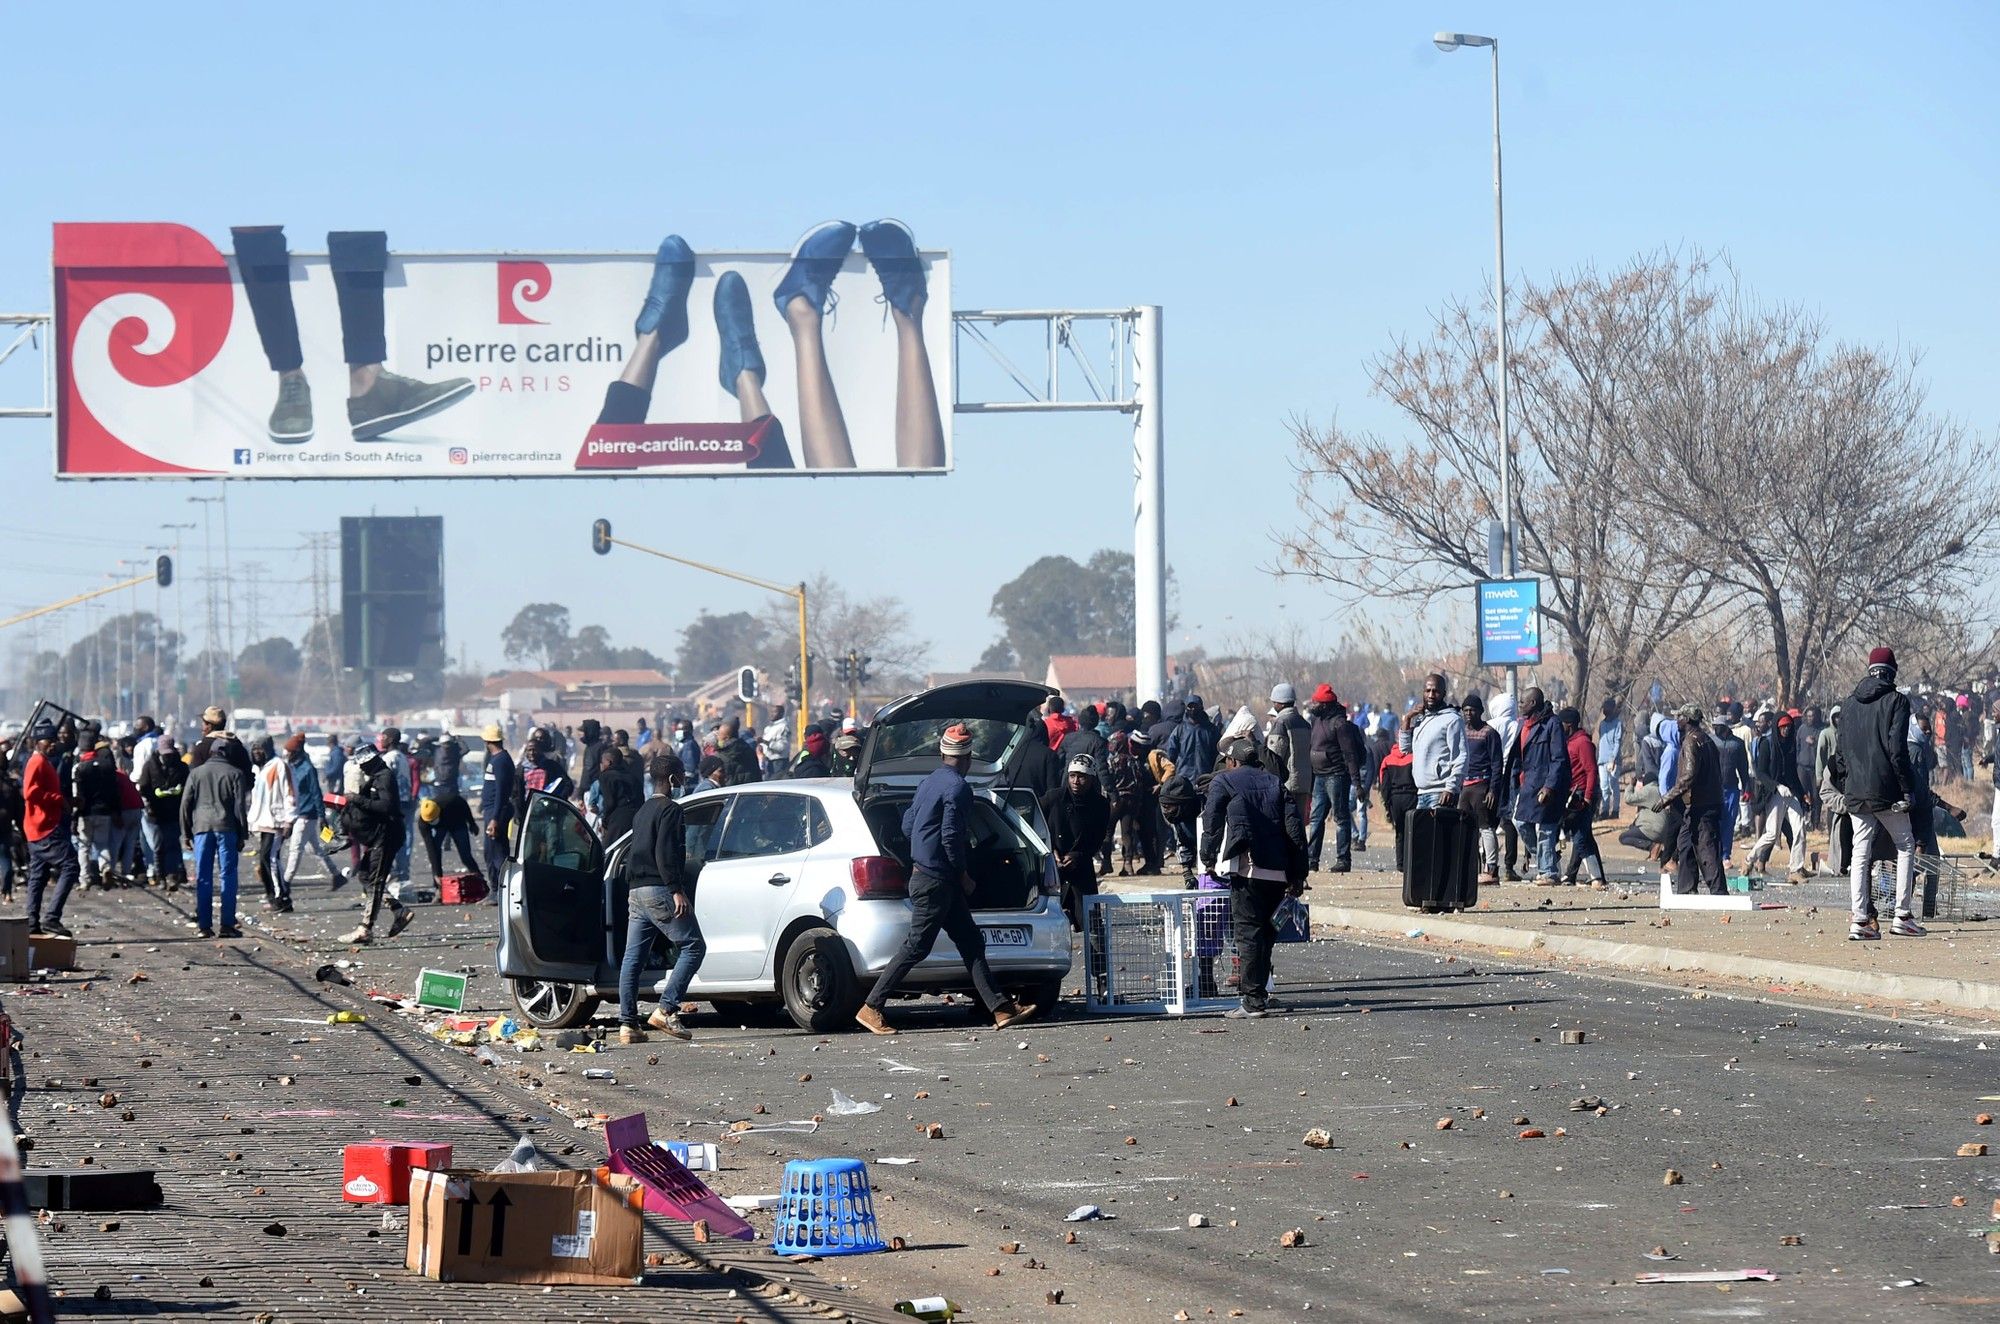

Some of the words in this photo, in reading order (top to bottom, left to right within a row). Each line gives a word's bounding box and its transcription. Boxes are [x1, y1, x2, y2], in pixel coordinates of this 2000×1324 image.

[426, 338, 517, 369] pierre
[525, 336, 623, 363] cardin
[479, 375, 572, 393] PARIS
[588, 436, 744, 457] pierre-cardin.co.za
[256, 452, 295, 463] Pierre
[298, 452, 341, 463] Cardin
[344, 451, 382, 463] South
[385, 451, 423, 463] Africa
[471, 450, 562, 464] pierrecardinza
